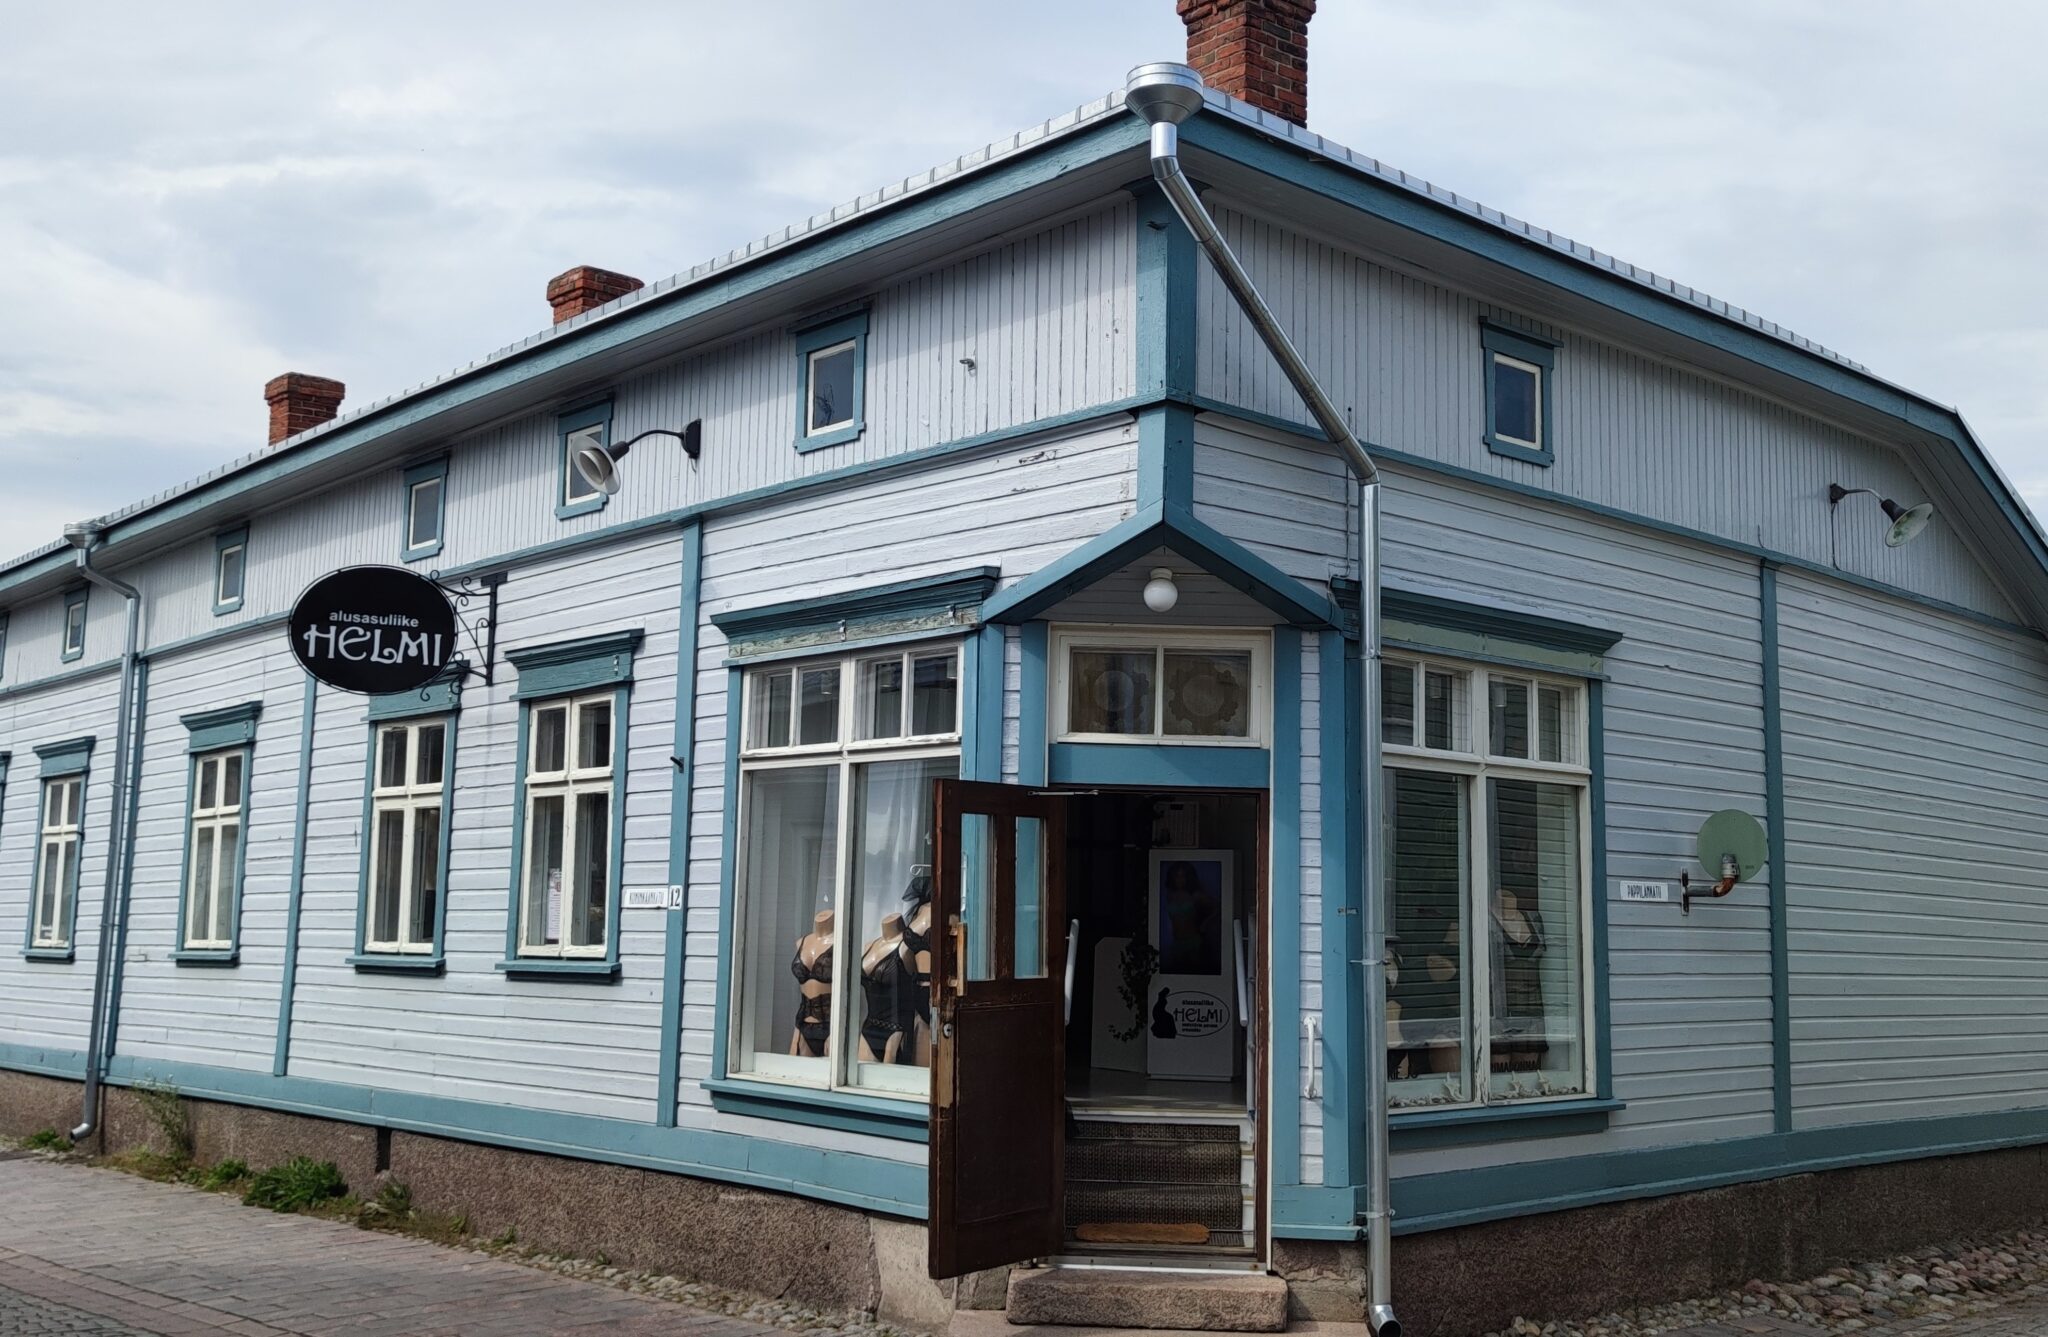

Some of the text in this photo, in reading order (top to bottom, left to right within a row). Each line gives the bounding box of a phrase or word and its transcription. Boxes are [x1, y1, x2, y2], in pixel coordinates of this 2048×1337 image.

[329, 610, 420, 628] alusasuliike
[303, 624, 443, 667] HELMI
[669, 887, 681, 907] 12
[1173, 1007, 1223, 1023] HELMI
